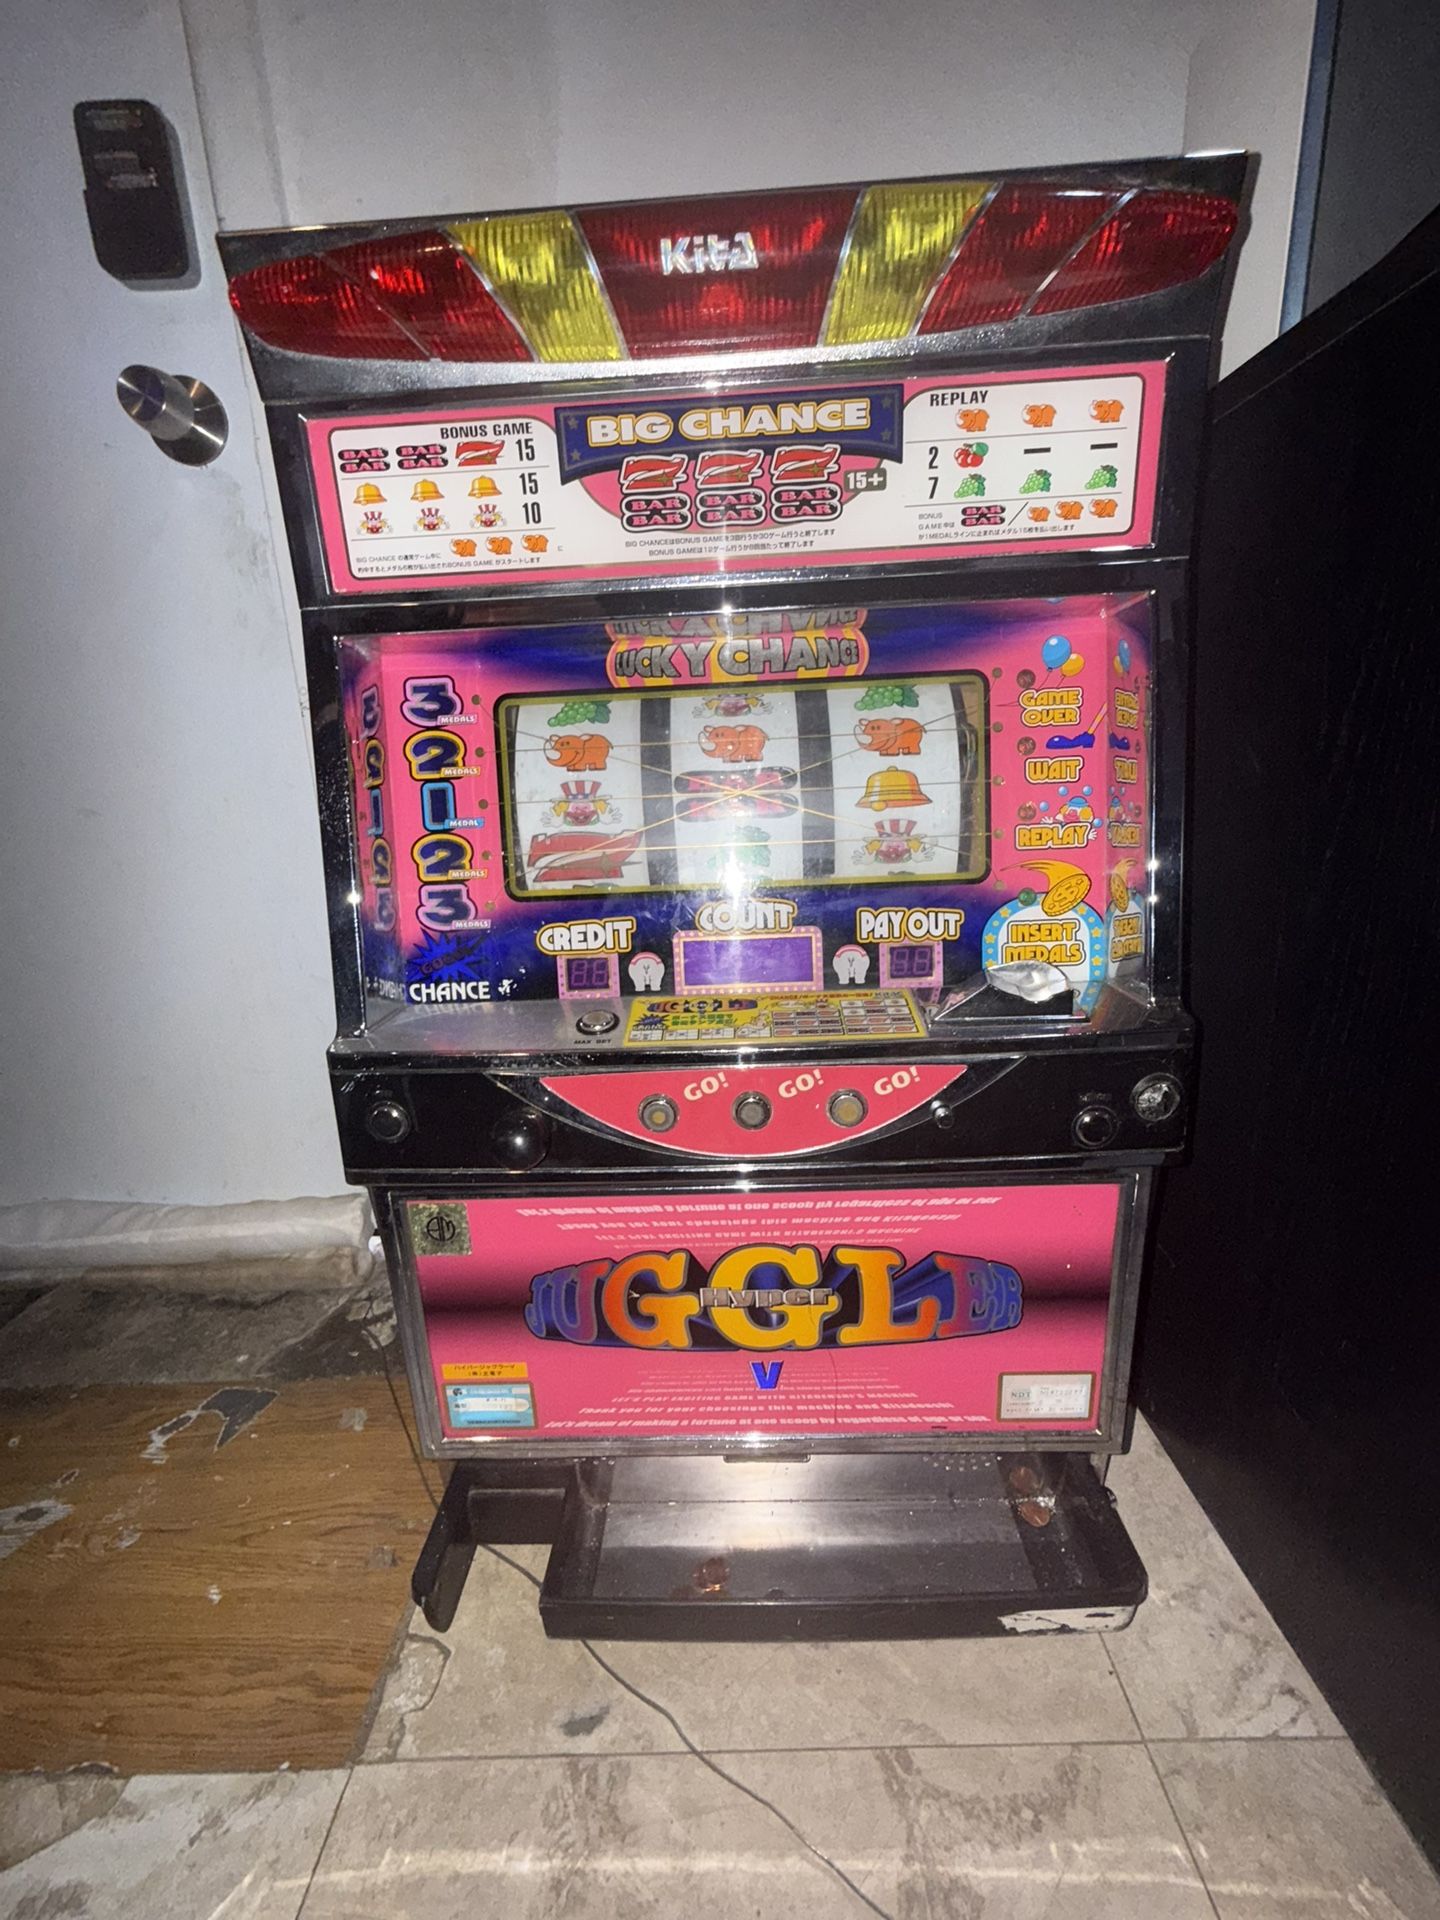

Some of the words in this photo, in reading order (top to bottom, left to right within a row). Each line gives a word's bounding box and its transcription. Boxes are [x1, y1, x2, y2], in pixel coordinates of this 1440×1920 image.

[930, 390, 988, 407] REPLAY
[440, 424, 488, 439] BONUS
[493, 422, 533, 436] GAME
[587, 412, 674, 447] BIG
[679, 399, 871, 441] CHANCE
[341, 448, 385, 460] BAR
[398, 445, 444, 456] BAR
[515, 438, 535, 461] 15
[928, 446, 939, 470] 2
[342, 462, 387, 473] BAR
[401, 458, 445, 469] BAR
[519, 472, 539, 495] 15
[846, 470, 884, 490] 15+
[928, 476, 939, 499] 7
[631, 498, 683, 511] BAR
[705, 493, 757, 508] BAR
[780, 487, 831, 501] BAR
[522, 502, 542, 524] 10
[631, 514, 684, 527] BAR
[705, 509, 758, 523] BAR
[780, 503, 833, 517] BAR
[615, 640, 715, 678] LUCKY
[401, 677, 463, 727] 3
[440, 715, 475, 723] MEDALS
[1020, 688, 1081, 707] GAME
[1023, 707, 1079, 725] OVER
[403, 728, 466, 780] 2
[444, 767, 478, 775] MEDALS
[1027, 758, 1082, 782] WAIT
[449, 819, 478, 827] MEDAL
[1018, 825, 1088, 847] REPLAY
[411, 833, 473, 883] 2
[451, 870, 485, 878] MEDALS
[416, 883, 478, 931] 3
[455, 920, 489, 928] MEDALS
[699, 902, 793, 932] COUNT
[539, 919, 635, 952] CREDIT
[859, 911, 908, 939] PAY
[908, 910, 961, 939] OUT
[1010, 922, 1077, 943] INSERT
[1005, 944, 1083, 963] MEDALS
[409, 981, 491, 1002] CHANCE
[683, 1072, 729, 1101] GO!
[778, 1069, 824, 1098] GO!
[874, 1066, 920, 1096] GO!
[751, 1361, 783, 1390] V
